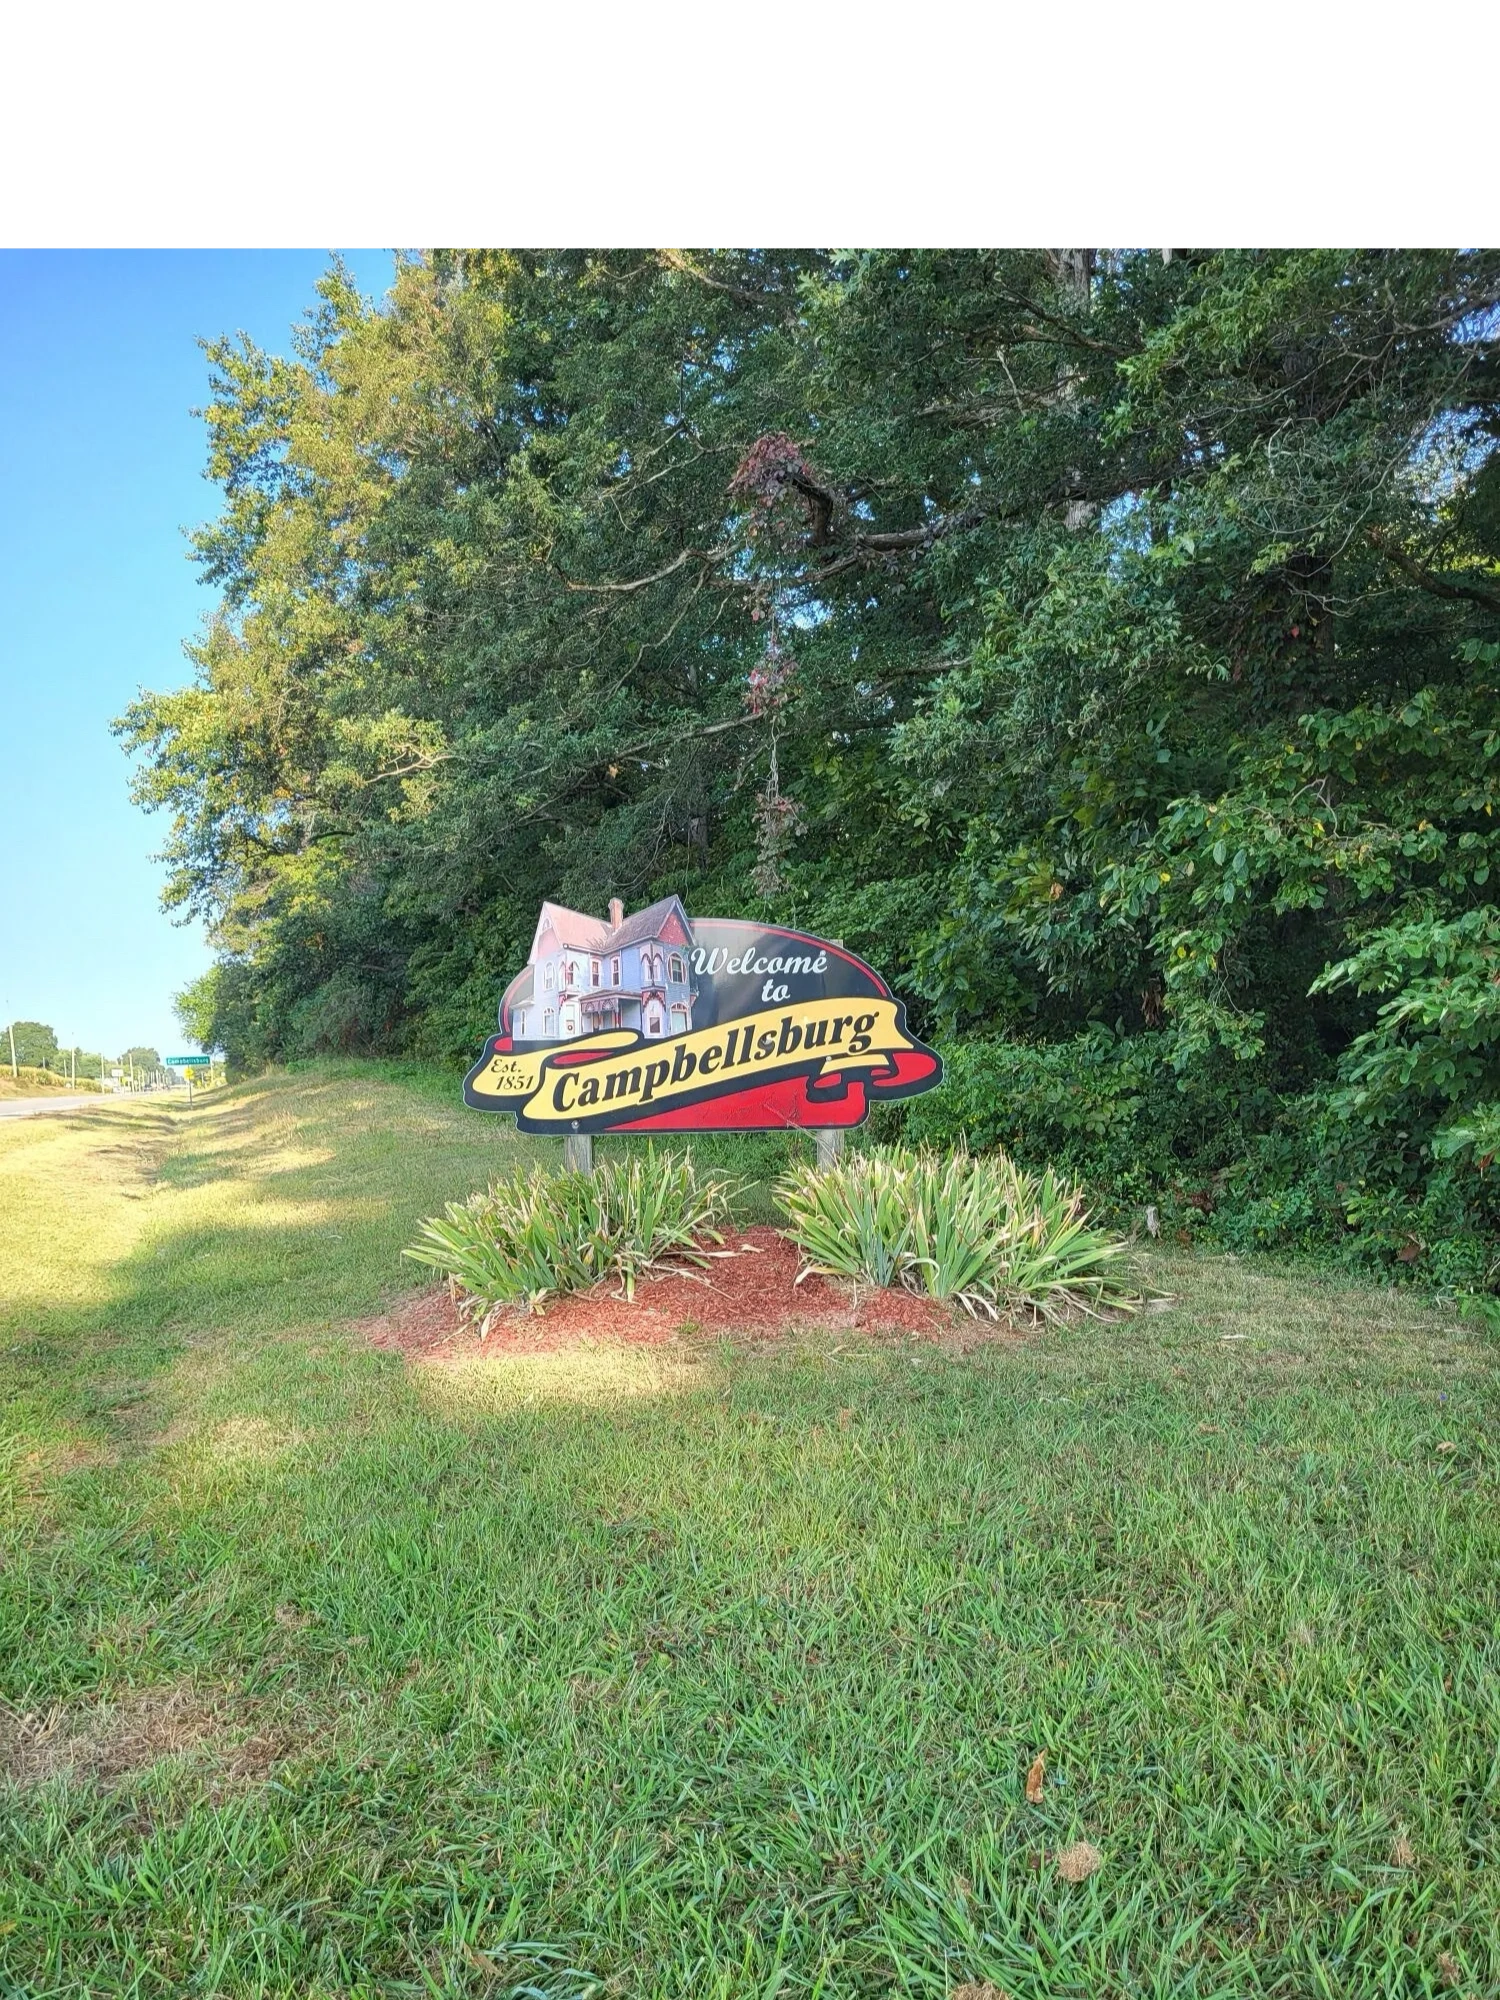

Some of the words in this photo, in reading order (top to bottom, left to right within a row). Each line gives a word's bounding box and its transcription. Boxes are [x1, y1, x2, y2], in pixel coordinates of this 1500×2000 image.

[690, 946, 828, 976] Welcome
[761, 978, 791, 1003] to
[491, 1058, 522, 1075] Est.
[551, 1010, 880, 1113] Campbellsburg
[496, 1074, 535, 1091] 1851
